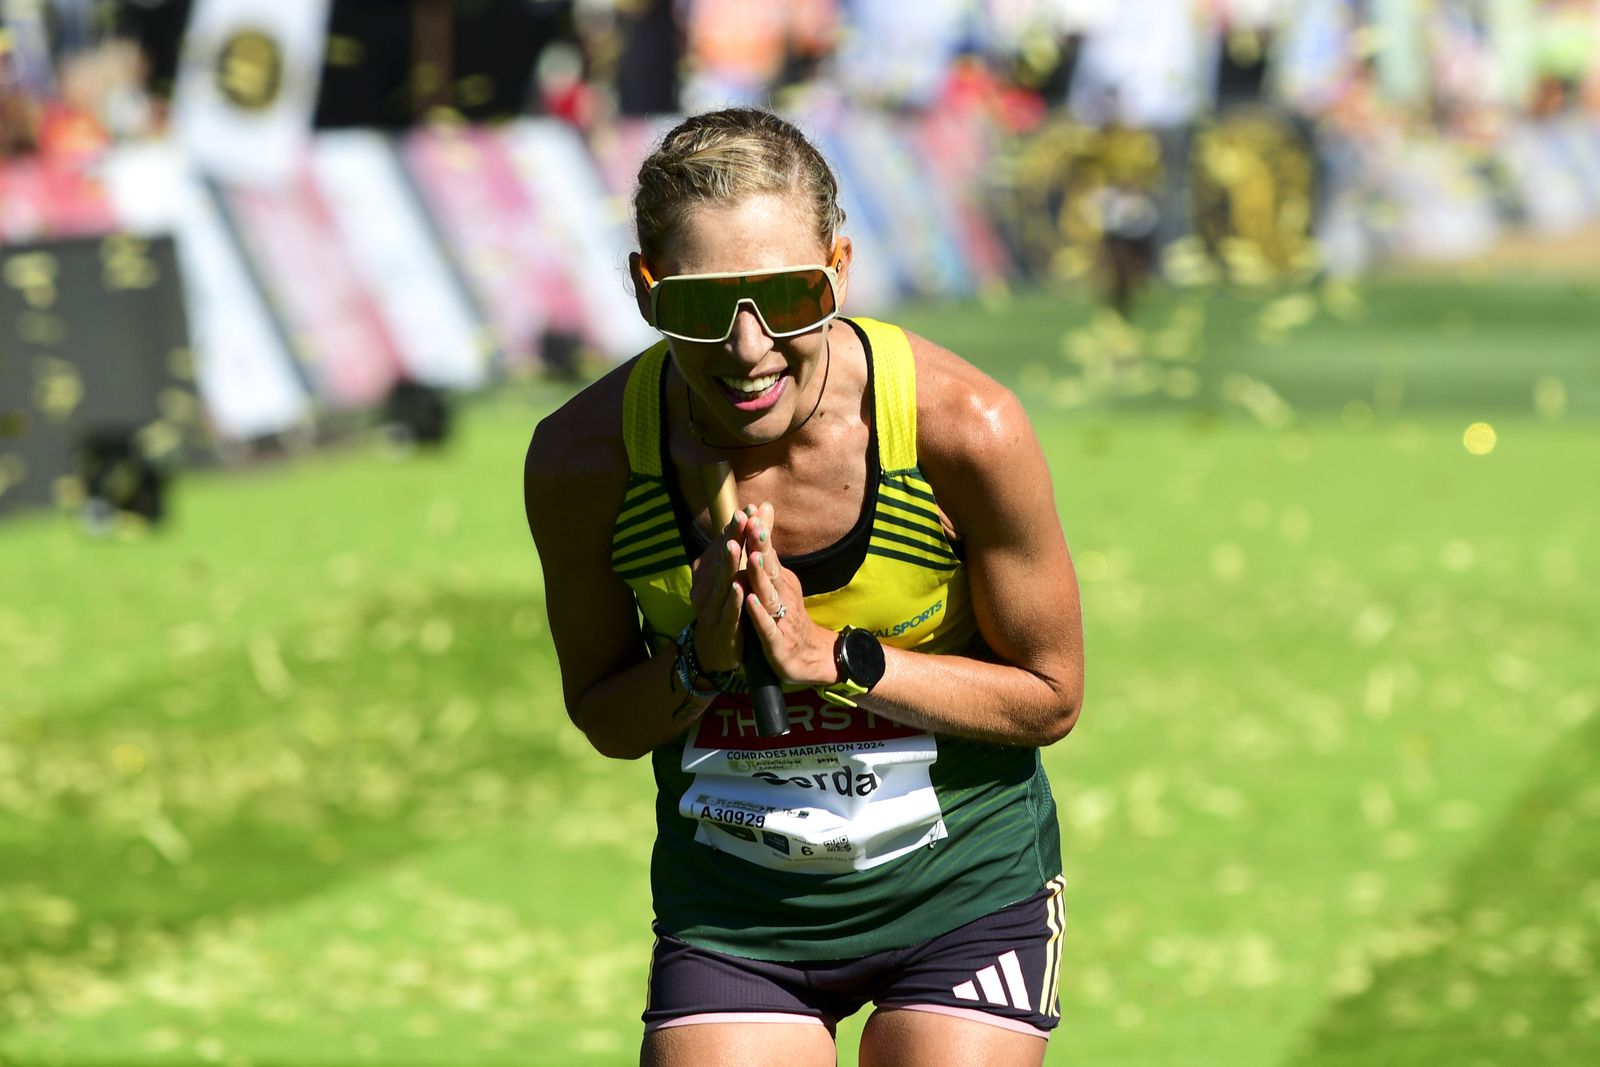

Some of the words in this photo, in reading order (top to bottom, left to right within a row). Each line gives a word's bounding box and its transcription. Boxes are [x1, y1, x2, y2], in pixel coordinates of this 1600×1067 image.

[727, 749, 787, 761] COMRADES
[789, 743, 854, 757] MARATHON
[857, 741, 885, 750] 2024
[700, 805, 766, 828] A30929
[801, 846, 814, 856] 6
